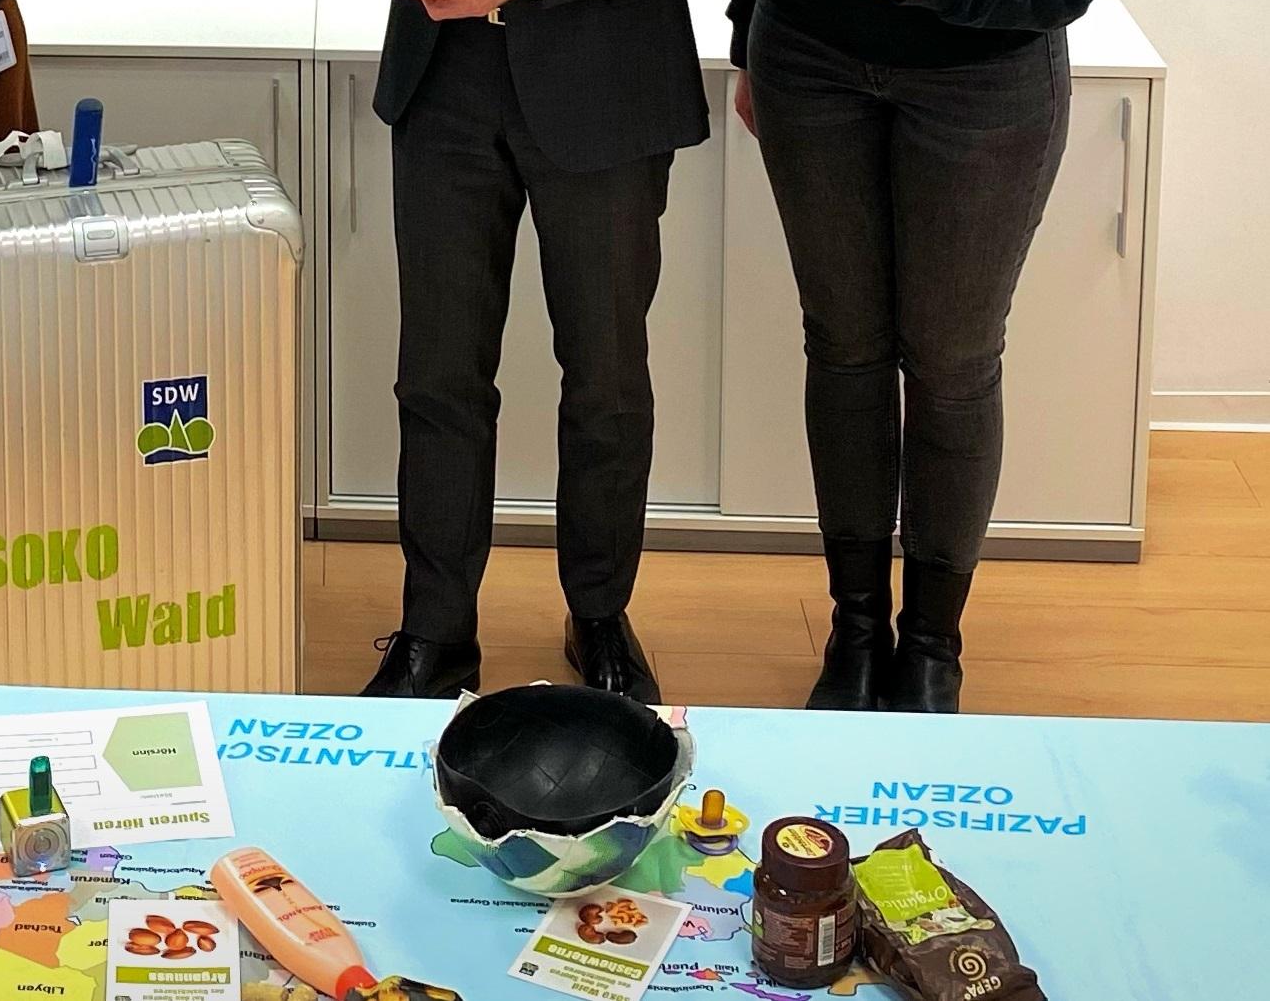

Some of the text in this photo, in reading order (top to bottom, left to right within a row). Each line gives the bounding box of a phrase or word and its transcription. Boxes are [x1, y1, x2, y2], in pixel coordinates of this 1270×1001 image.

[152, 383, 200, 406] SDW
[96, 583, 236, 651] Wald
[228, 719, 363, 741] OZEAN
[131, 747, 176, 758] Hörsinn
[872, 782, 1013, 805] OZEAN
[92, 810, 210, 832] Spuren Hören
[814, 805, 1086, 835] PAZIFISCHER
[70, 875, 130, 885] Kamerun
[14, 923, 62, 934] Tschad
[87, 938, 109, 947] ger
[547, 944, 643, 979] Cashewkerne
[148, 971, 227, 984] Argannuss
[965, 975, 1002, 998] GEPA
[17, 984, 65, 995] Libyen
